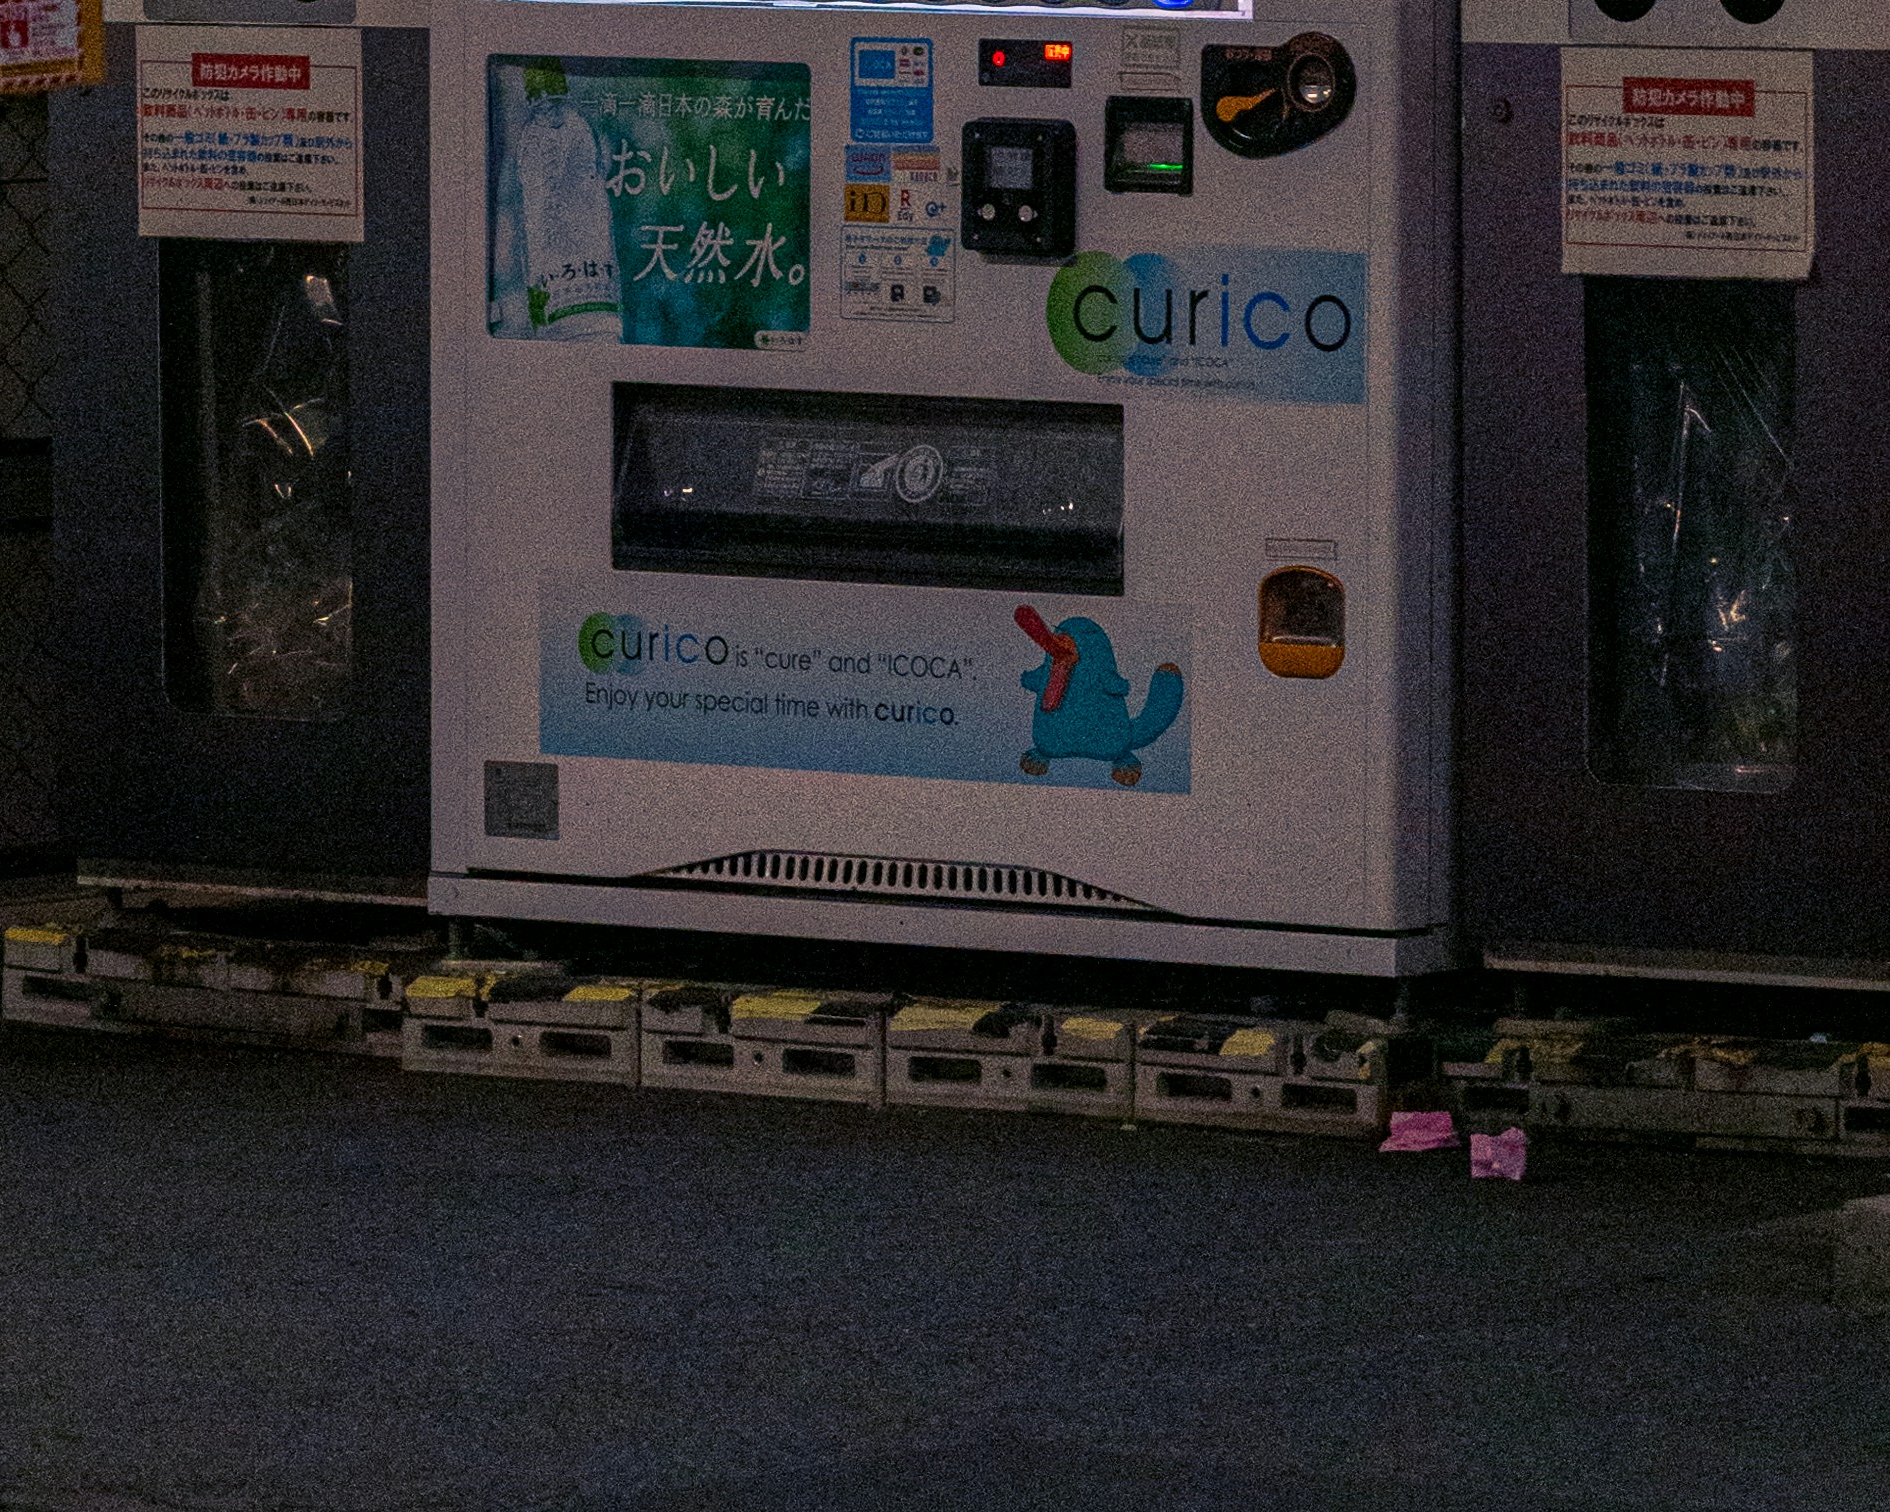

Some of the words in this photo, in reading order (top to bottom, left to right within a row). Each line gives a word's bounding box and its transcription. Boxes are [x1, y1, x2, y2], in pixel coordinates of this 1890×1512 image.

[606, 139, 786, 202] おいしい
[633, 222, 806, 287] 天然水。
[1073, 274, 1351, 353] curico
[591, 624, 728, 665] curico
[736, 645, 748, 667] is
[829, 653, 870, 675] and
[585, 682, 638, 710] Enjoy
[646, 689, 690, 713] your
[694, 690, 768, 720] special
[775, 695, 820, 719] time
[825, 700, 867, 721] with
[873, 703, 959, 726] curico.
